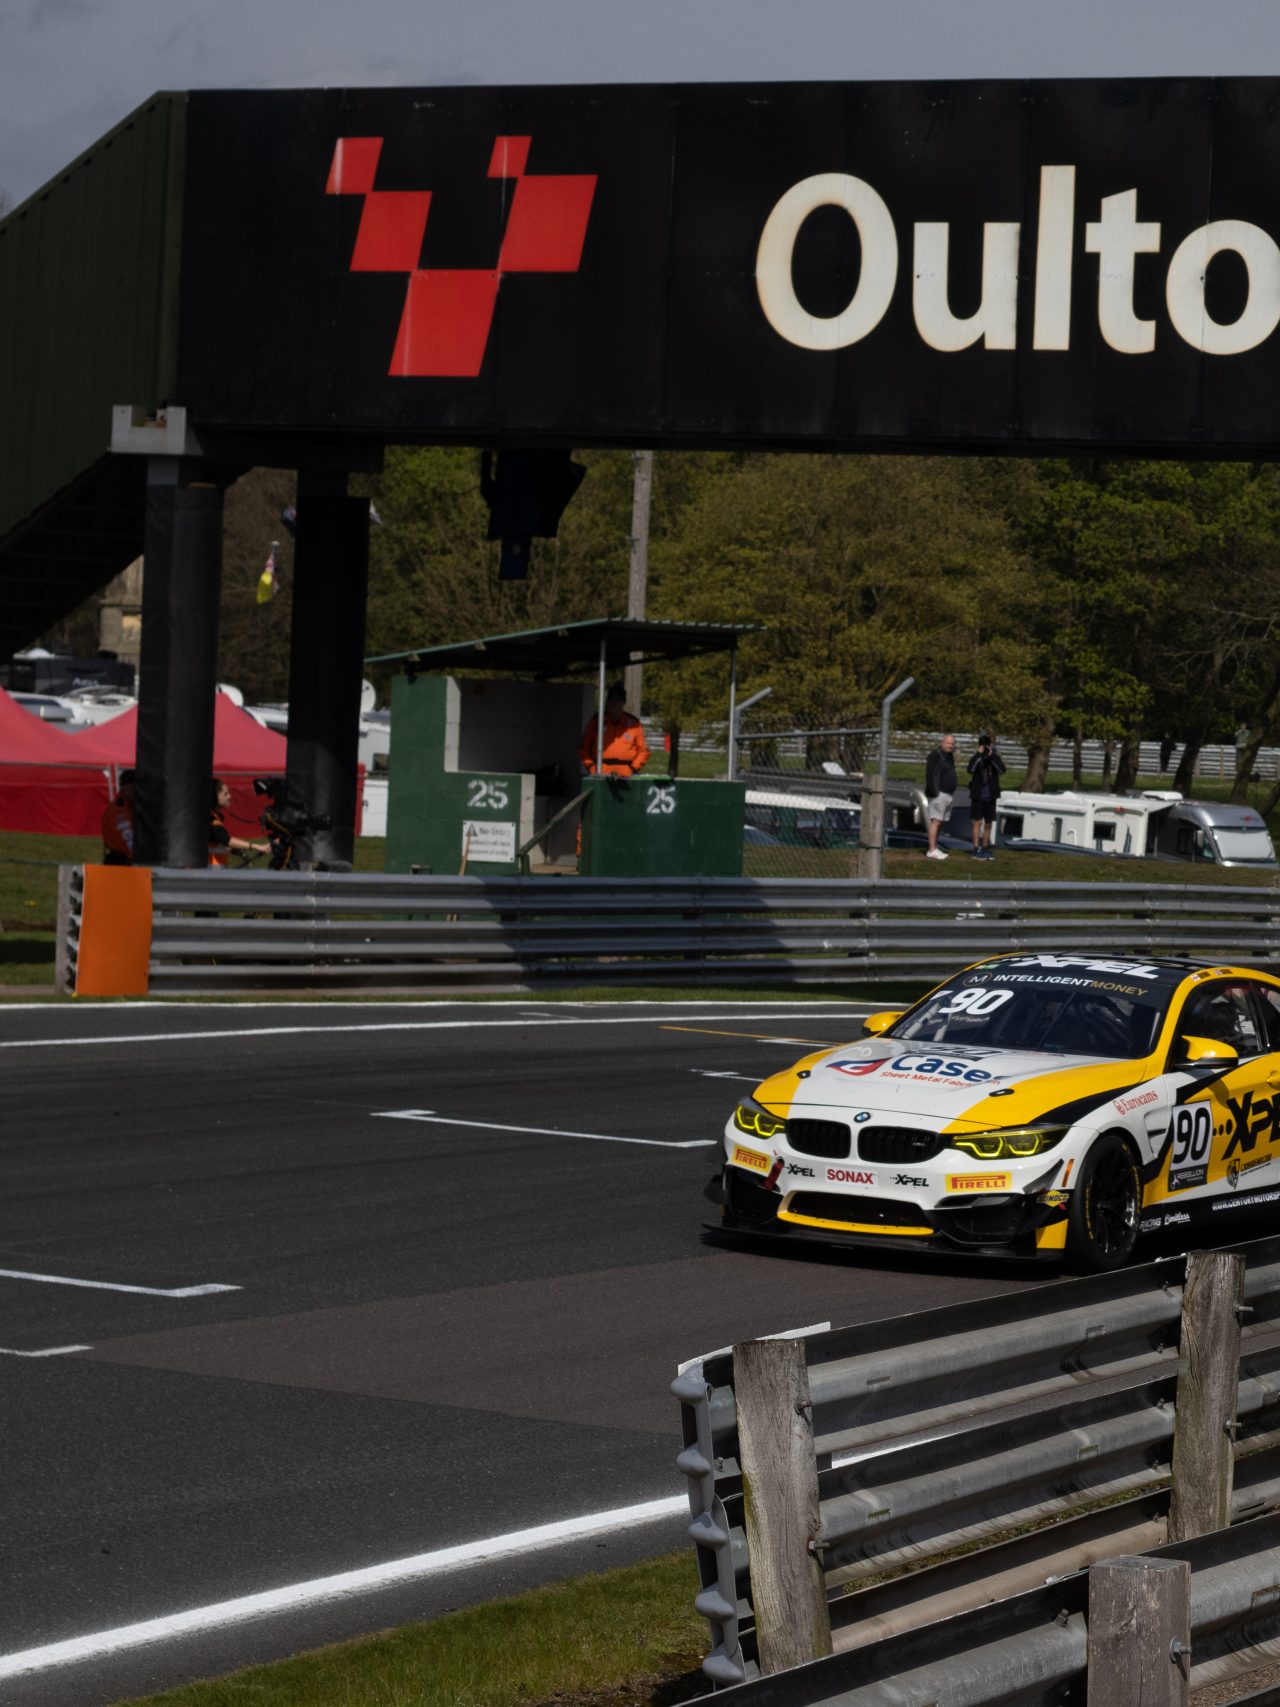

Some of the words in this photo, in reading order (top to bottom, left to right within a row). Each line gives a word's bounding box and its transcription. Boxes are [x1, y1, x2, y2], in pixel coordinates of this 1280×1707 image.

[467, 779, 508, 809] 25
[646, 785, 676, 814] 25
[937, 987, 1014, 1015] 90
[891, 1055, 1010, 1083] Case
[1120, 1091, 1158, 1111] Eurocams
[1172, 1107, 1210, 1164] 90
[735, 1149, 767, 1169] PIRELLI
[788, 1164, 815, 1177] XPEL
[827, 1169, 873, 1184] SONAX
[895, 1174, 929, 1187] XPEL
[951, 1175, 1006, 1189] PIRELLI
